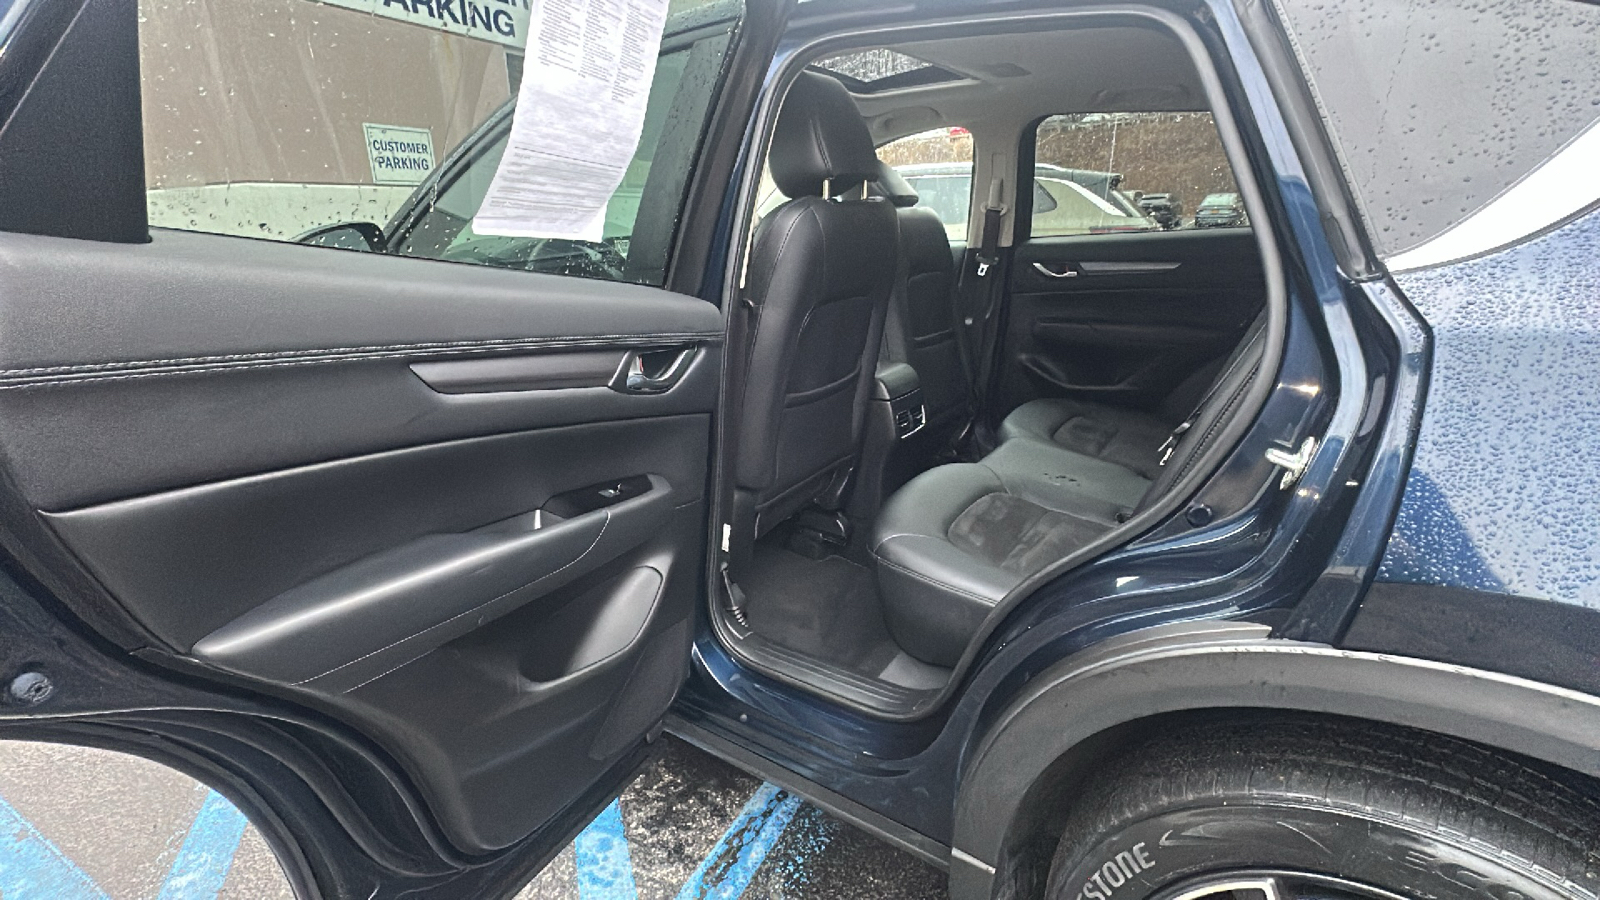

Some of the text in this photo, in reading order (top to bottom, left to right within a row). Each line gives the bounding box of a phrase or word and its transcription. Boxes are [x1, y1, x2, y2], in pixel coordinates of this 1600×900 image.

[383, 0, 516, 38] RKING
[372, 139, 429, 154] CUSTOMER
[376, 156, 430, 171] PARKING
[1076, 841, 1156, 900] STONE
